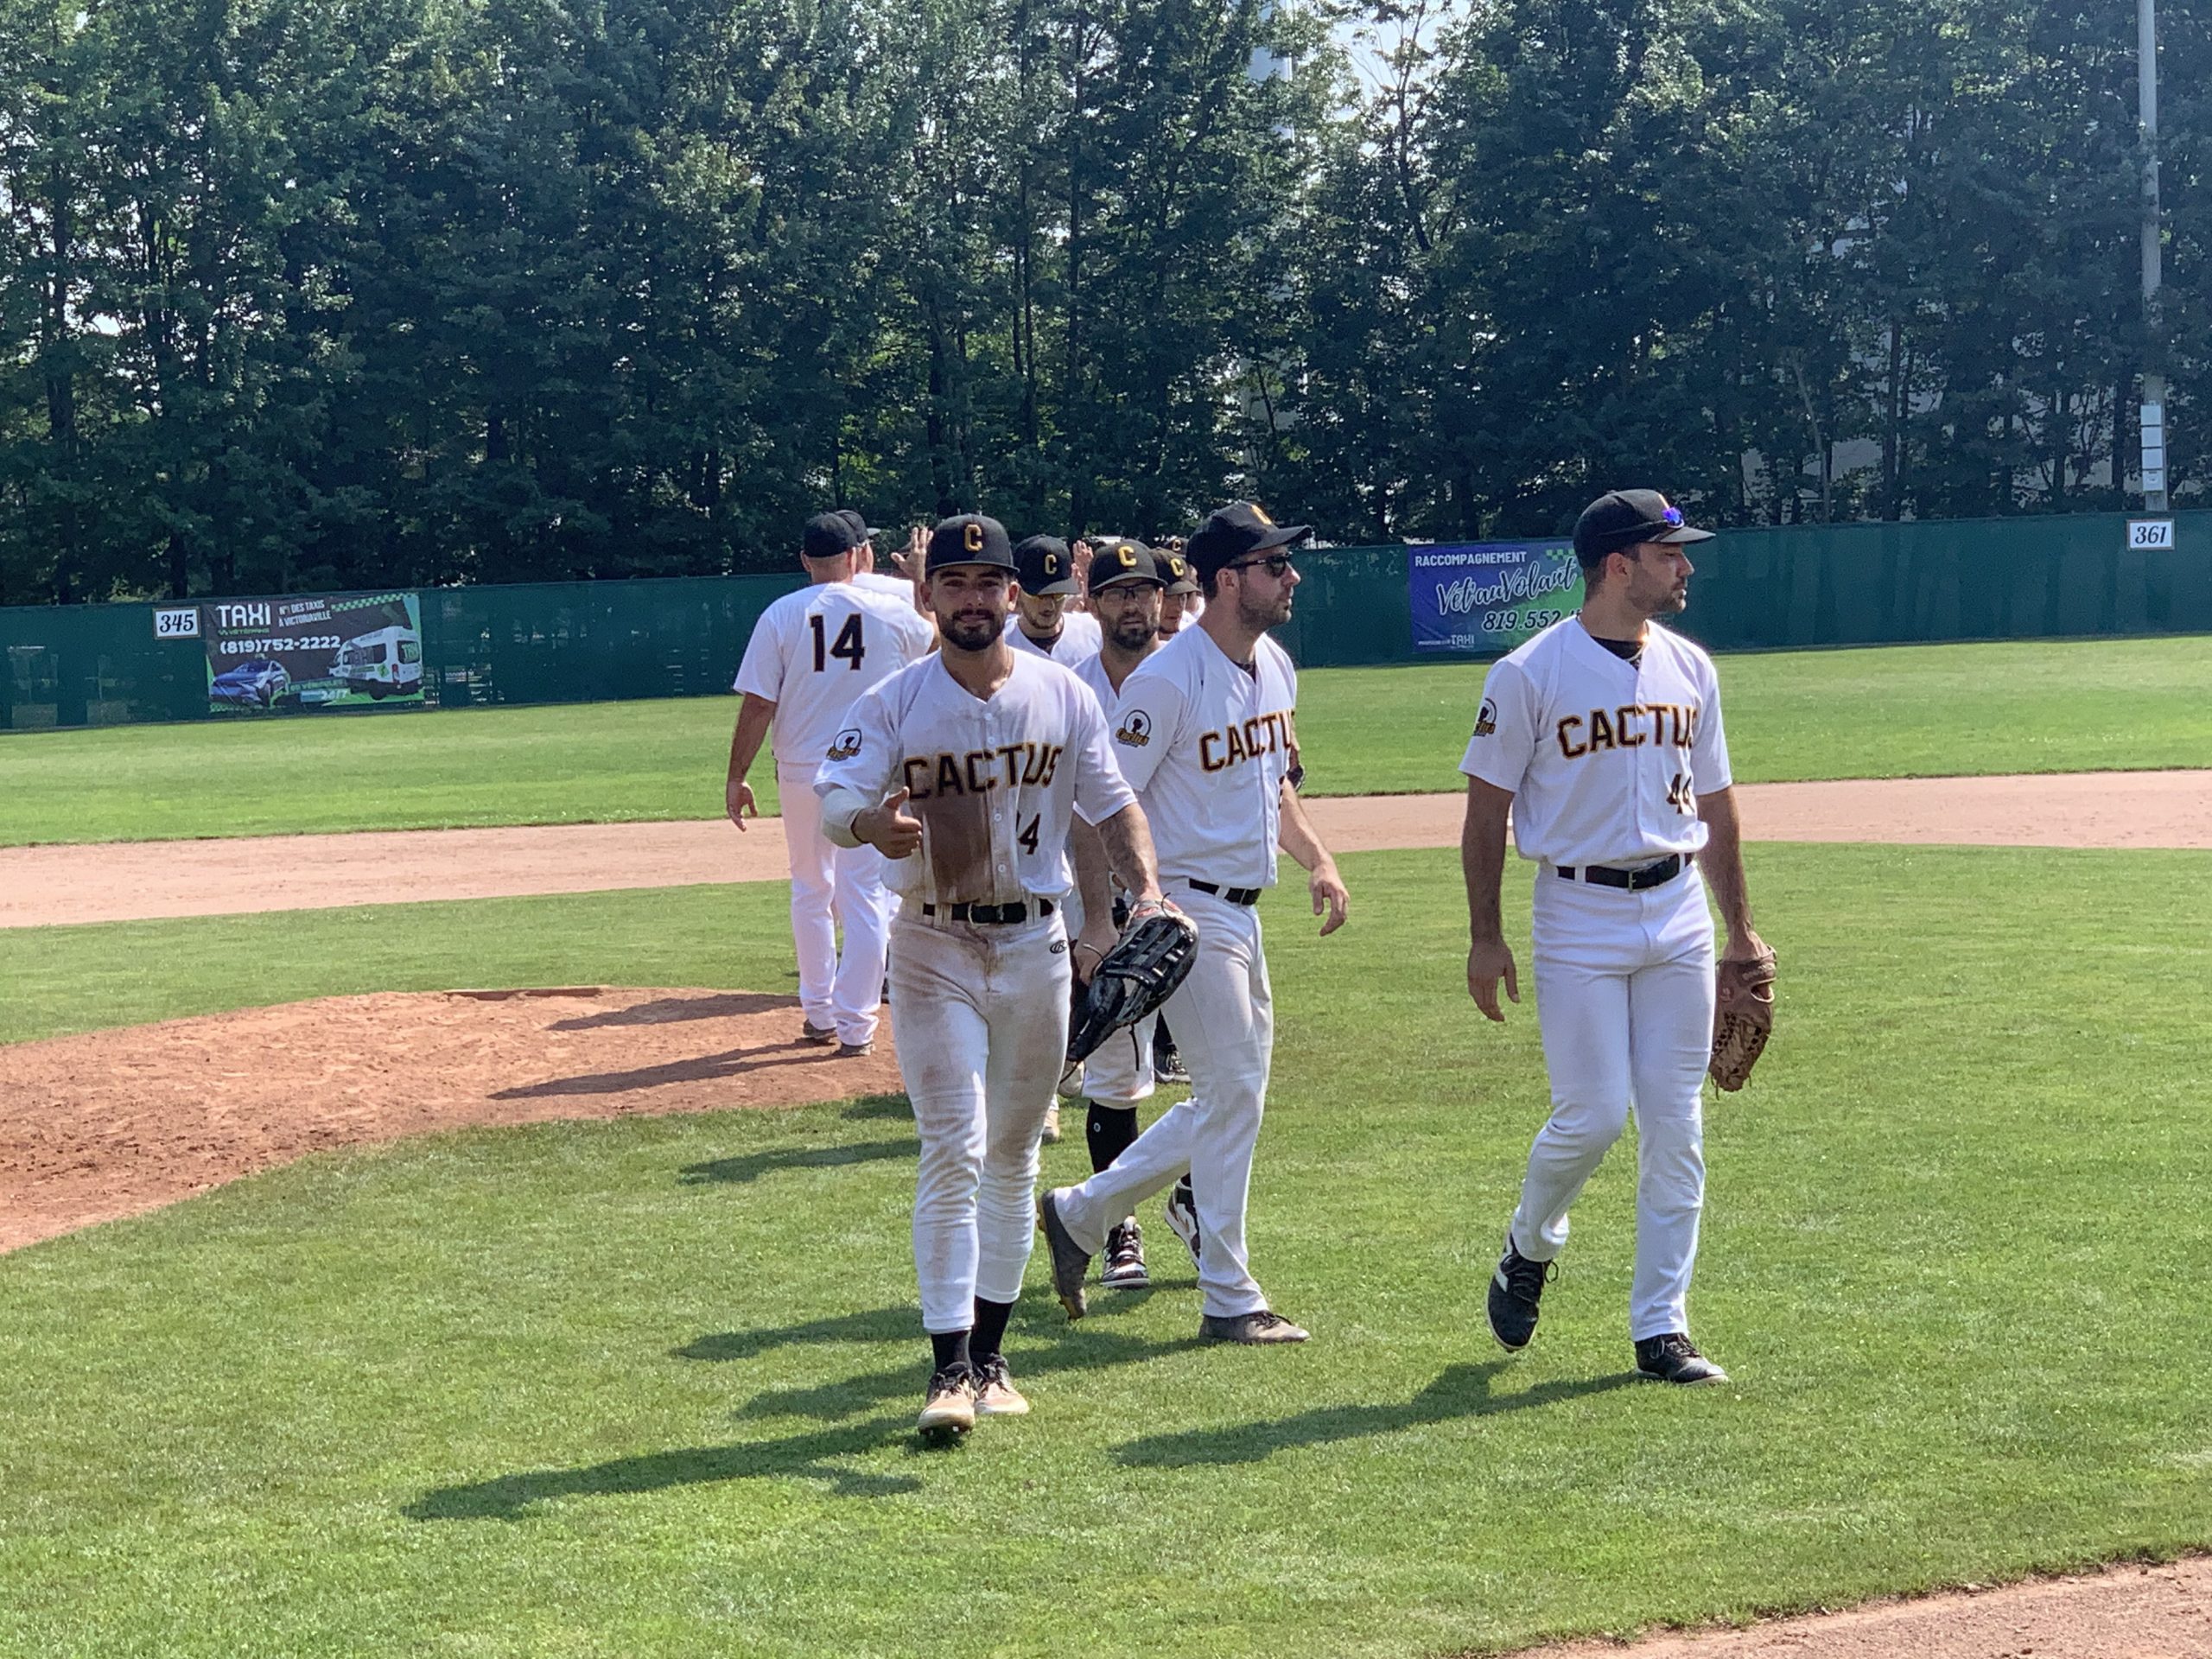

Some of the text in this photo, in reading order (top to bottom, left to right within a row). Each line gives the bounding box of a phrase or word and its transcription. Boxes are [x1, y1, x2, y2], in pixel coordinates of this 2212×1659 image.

[963, 524, 983, 551] C
[2135, 525, 2166, 544] 361
[1173, 539, 1182, 551] C
[1045, 555, 1058, 575] C
[1118, 546, 1137, 566] C
[1415, 551, 1527, 567] RACCOMPAGNEMENT
[1171, 557, 1185, 577] C
[217, 603, 271, 628] TAXI
[291, 603, 305, 613] DES
[159, 613, 194, 632] 345
[219, 636, 340, 655] (819)752-2222
[809, 613, 866, 672] 14
[1451, 634, 1475, 645] TAXI
[1557, 703, 1698, 760] CACTU
[904, 741, 1064, 799] CACTUS
